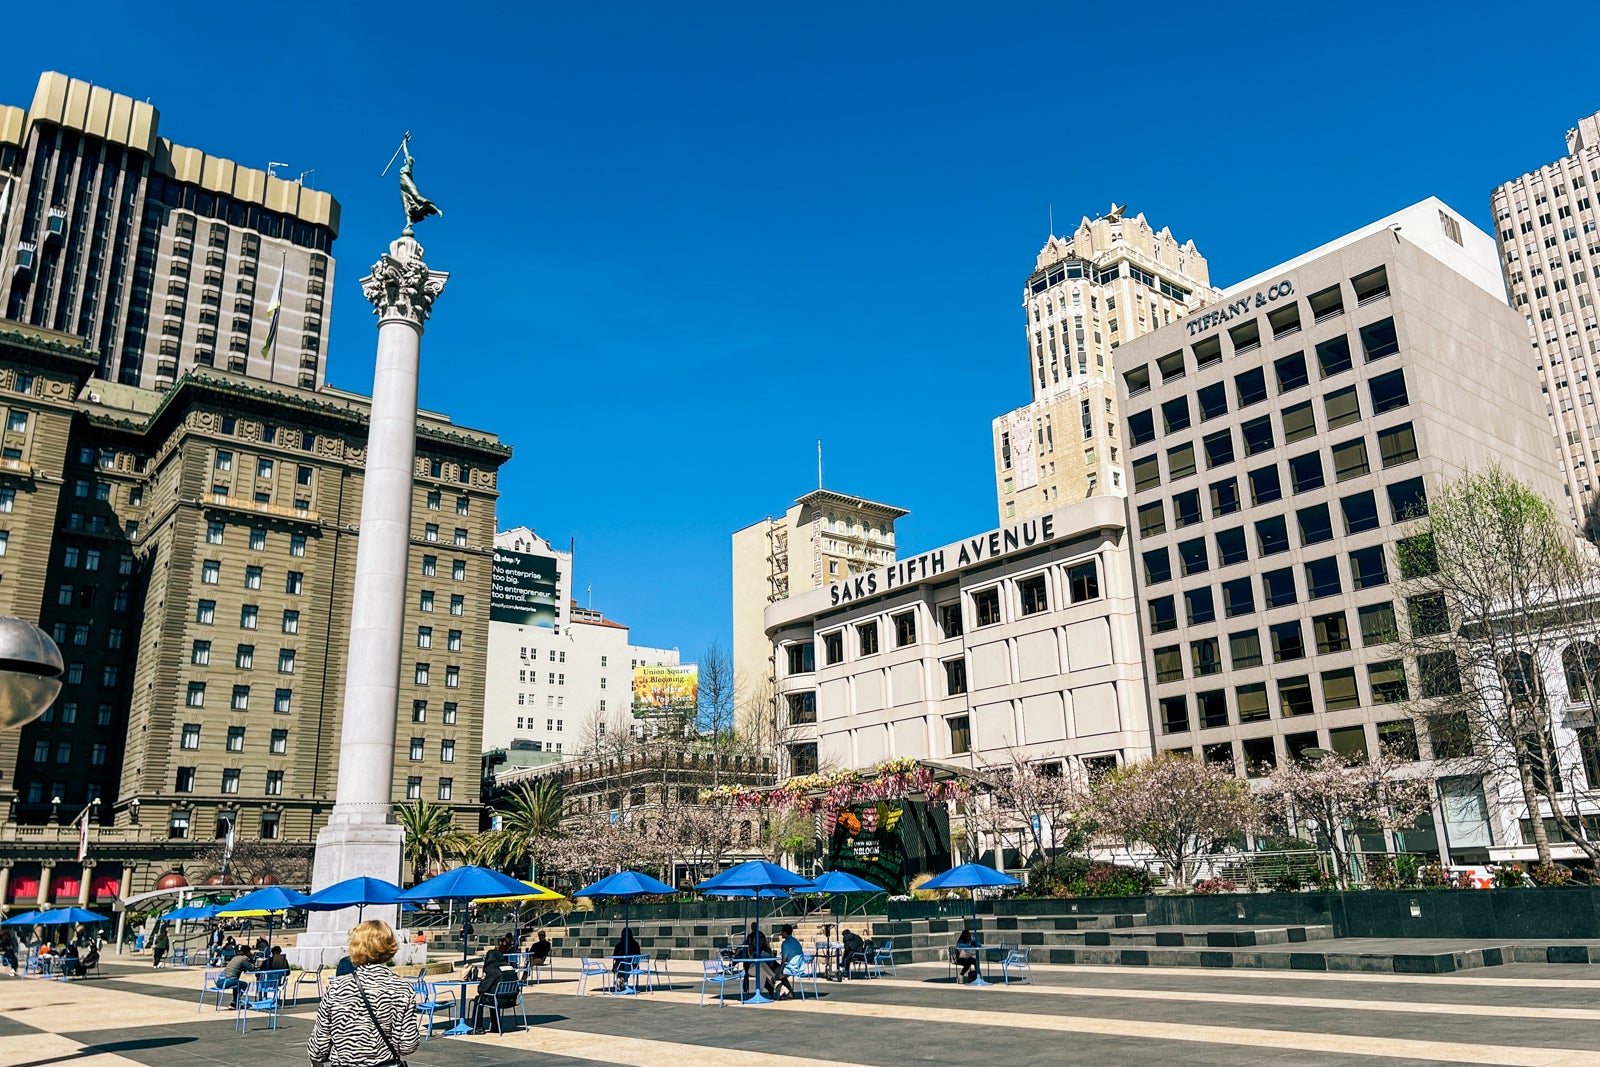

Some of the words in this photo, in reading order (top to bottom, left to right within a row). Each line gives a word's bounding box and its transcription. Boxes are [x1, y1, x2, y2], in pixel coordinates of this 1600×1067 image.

[1186, 296, 1251, 336] TIFFANY
[1255, 291, 1267, 308] &
[830, 572, 877, 606] SAKS
[886, 550, 945, 589] FIFTH
[958, 514, 1055, 568] AVENUE
[492, 565, 504, 574] No
[505, 569, 541, 579] enterprise
[506, 576, 519, 584] big.
[491, 583, 504, 591] No
[504, 587, 551, 598] entrepreneur
[491, 591, 504, 599] too
[505, 594, 526, 602] small.
[666, 668, 690, 676] Square
